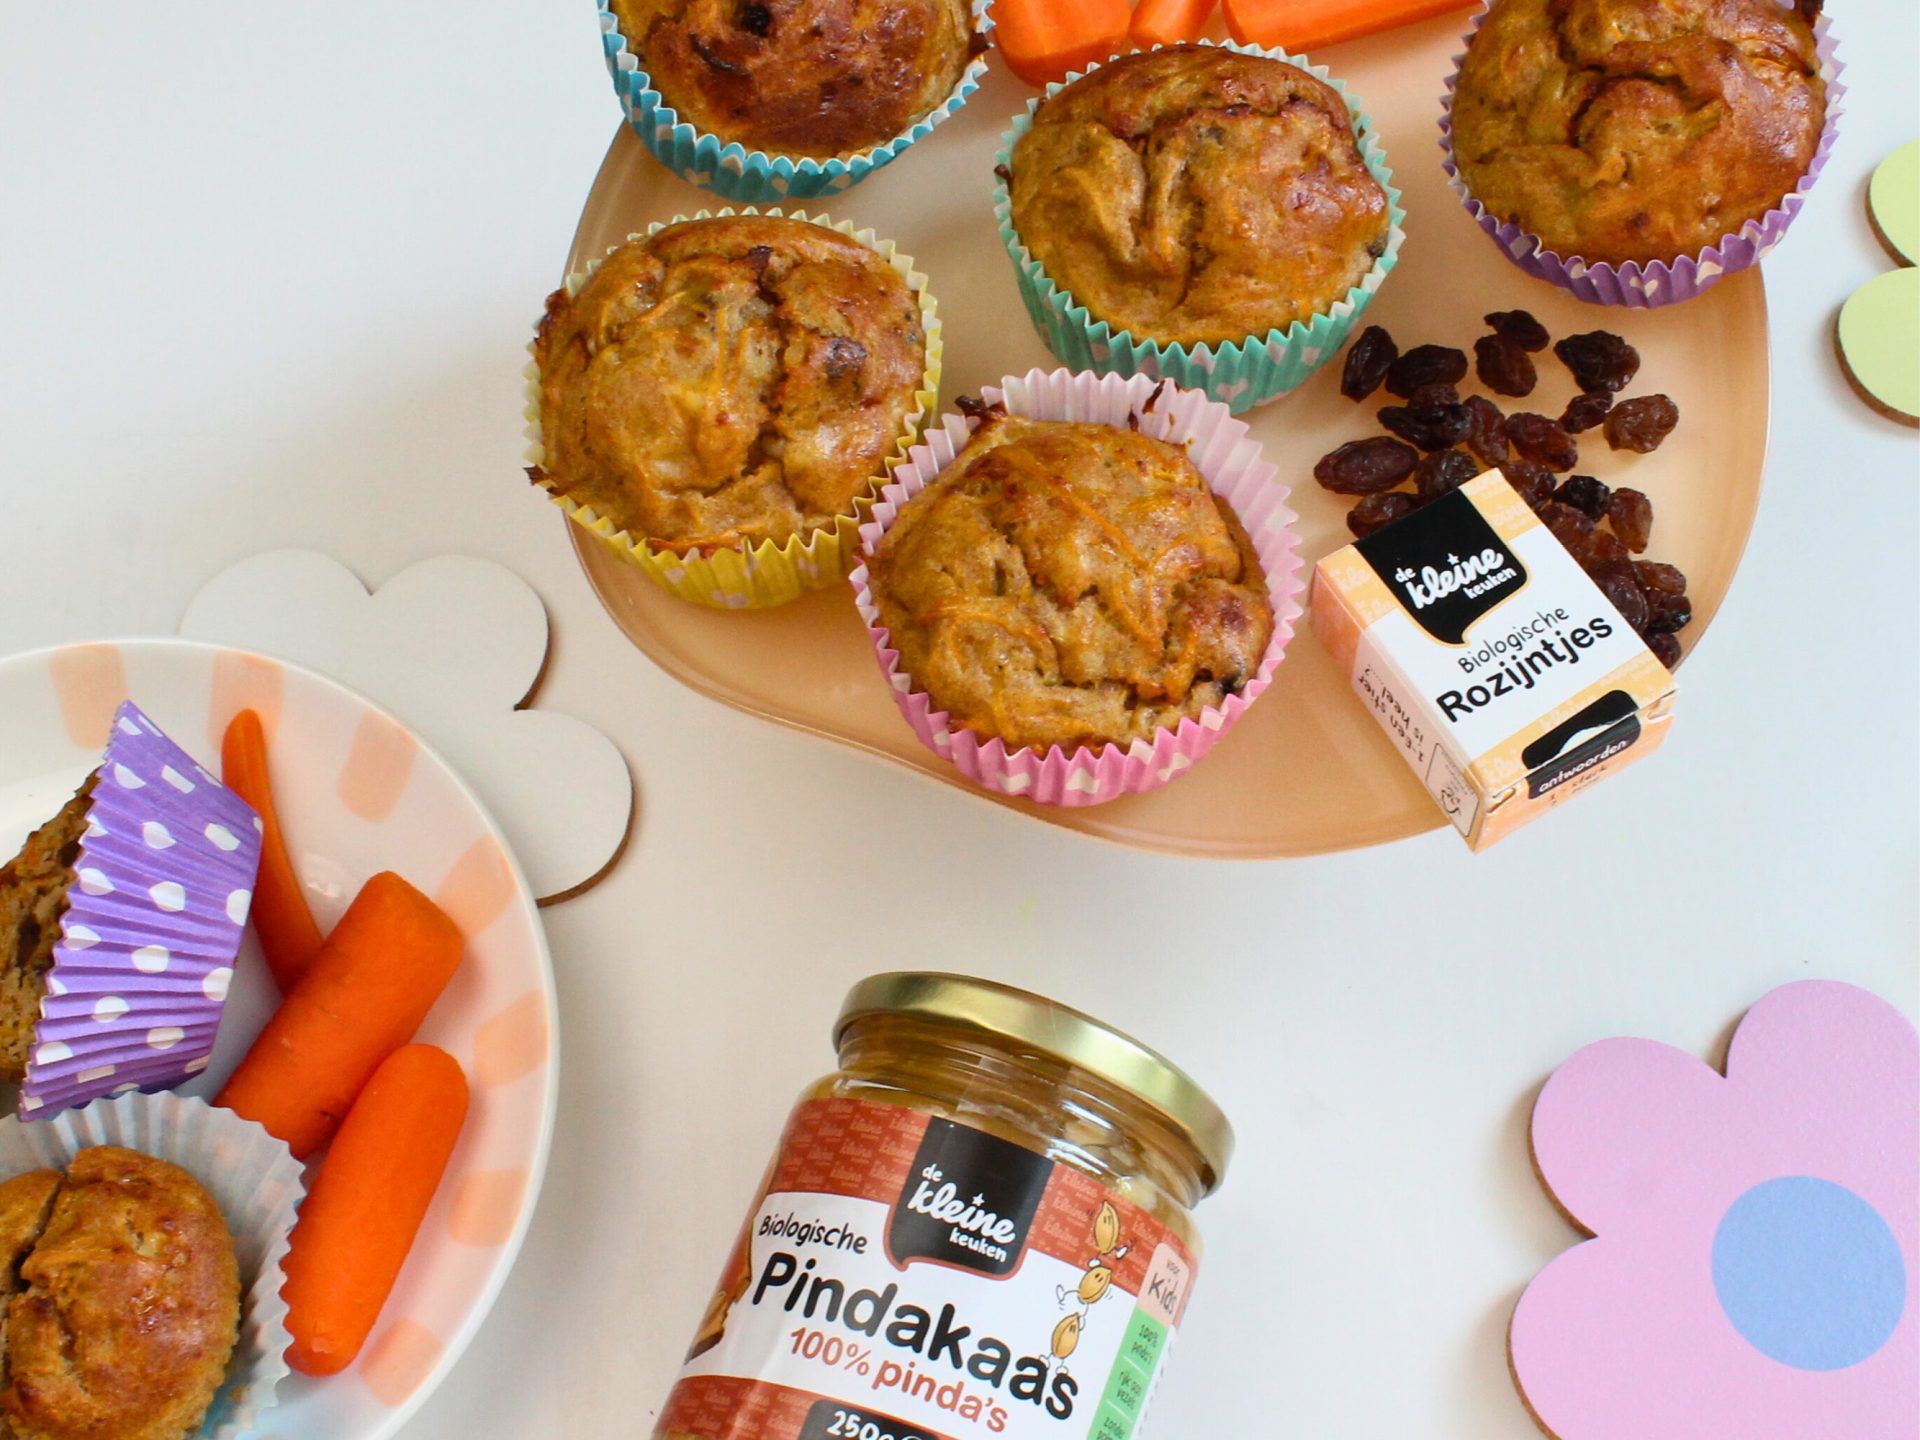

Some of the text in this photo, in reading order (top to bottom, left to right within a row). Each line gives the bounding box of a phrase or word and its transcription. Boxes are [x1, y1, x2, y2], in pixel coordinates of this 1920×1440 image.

[1395, 567, 1416, 583] de
[1405, 548, 1504, 609] kleine
[1463, 567, 1518, 599] keuken
[1457, 607, 1570, 674] Biologische
[1357, 674, 1386, 713] stier
[1436, 617, 1613, 723] Rozijntjes
[1538, 739, 1628, 793] antwoorden
[922, 1163, 943, 1182] de
[758, 1212, 867, 1254] Biologische
[907, 1180, 1016, 1243] kleine
[950, 1228, 1007, 1262] keuken
[1148, 1272, 1179, 1315] Kids
[752, 1252, 1079, 1420] Pindakaas
[790, 1326, 872, 1377] 100%
[872, 1360, 1008, 1432] pinda's
